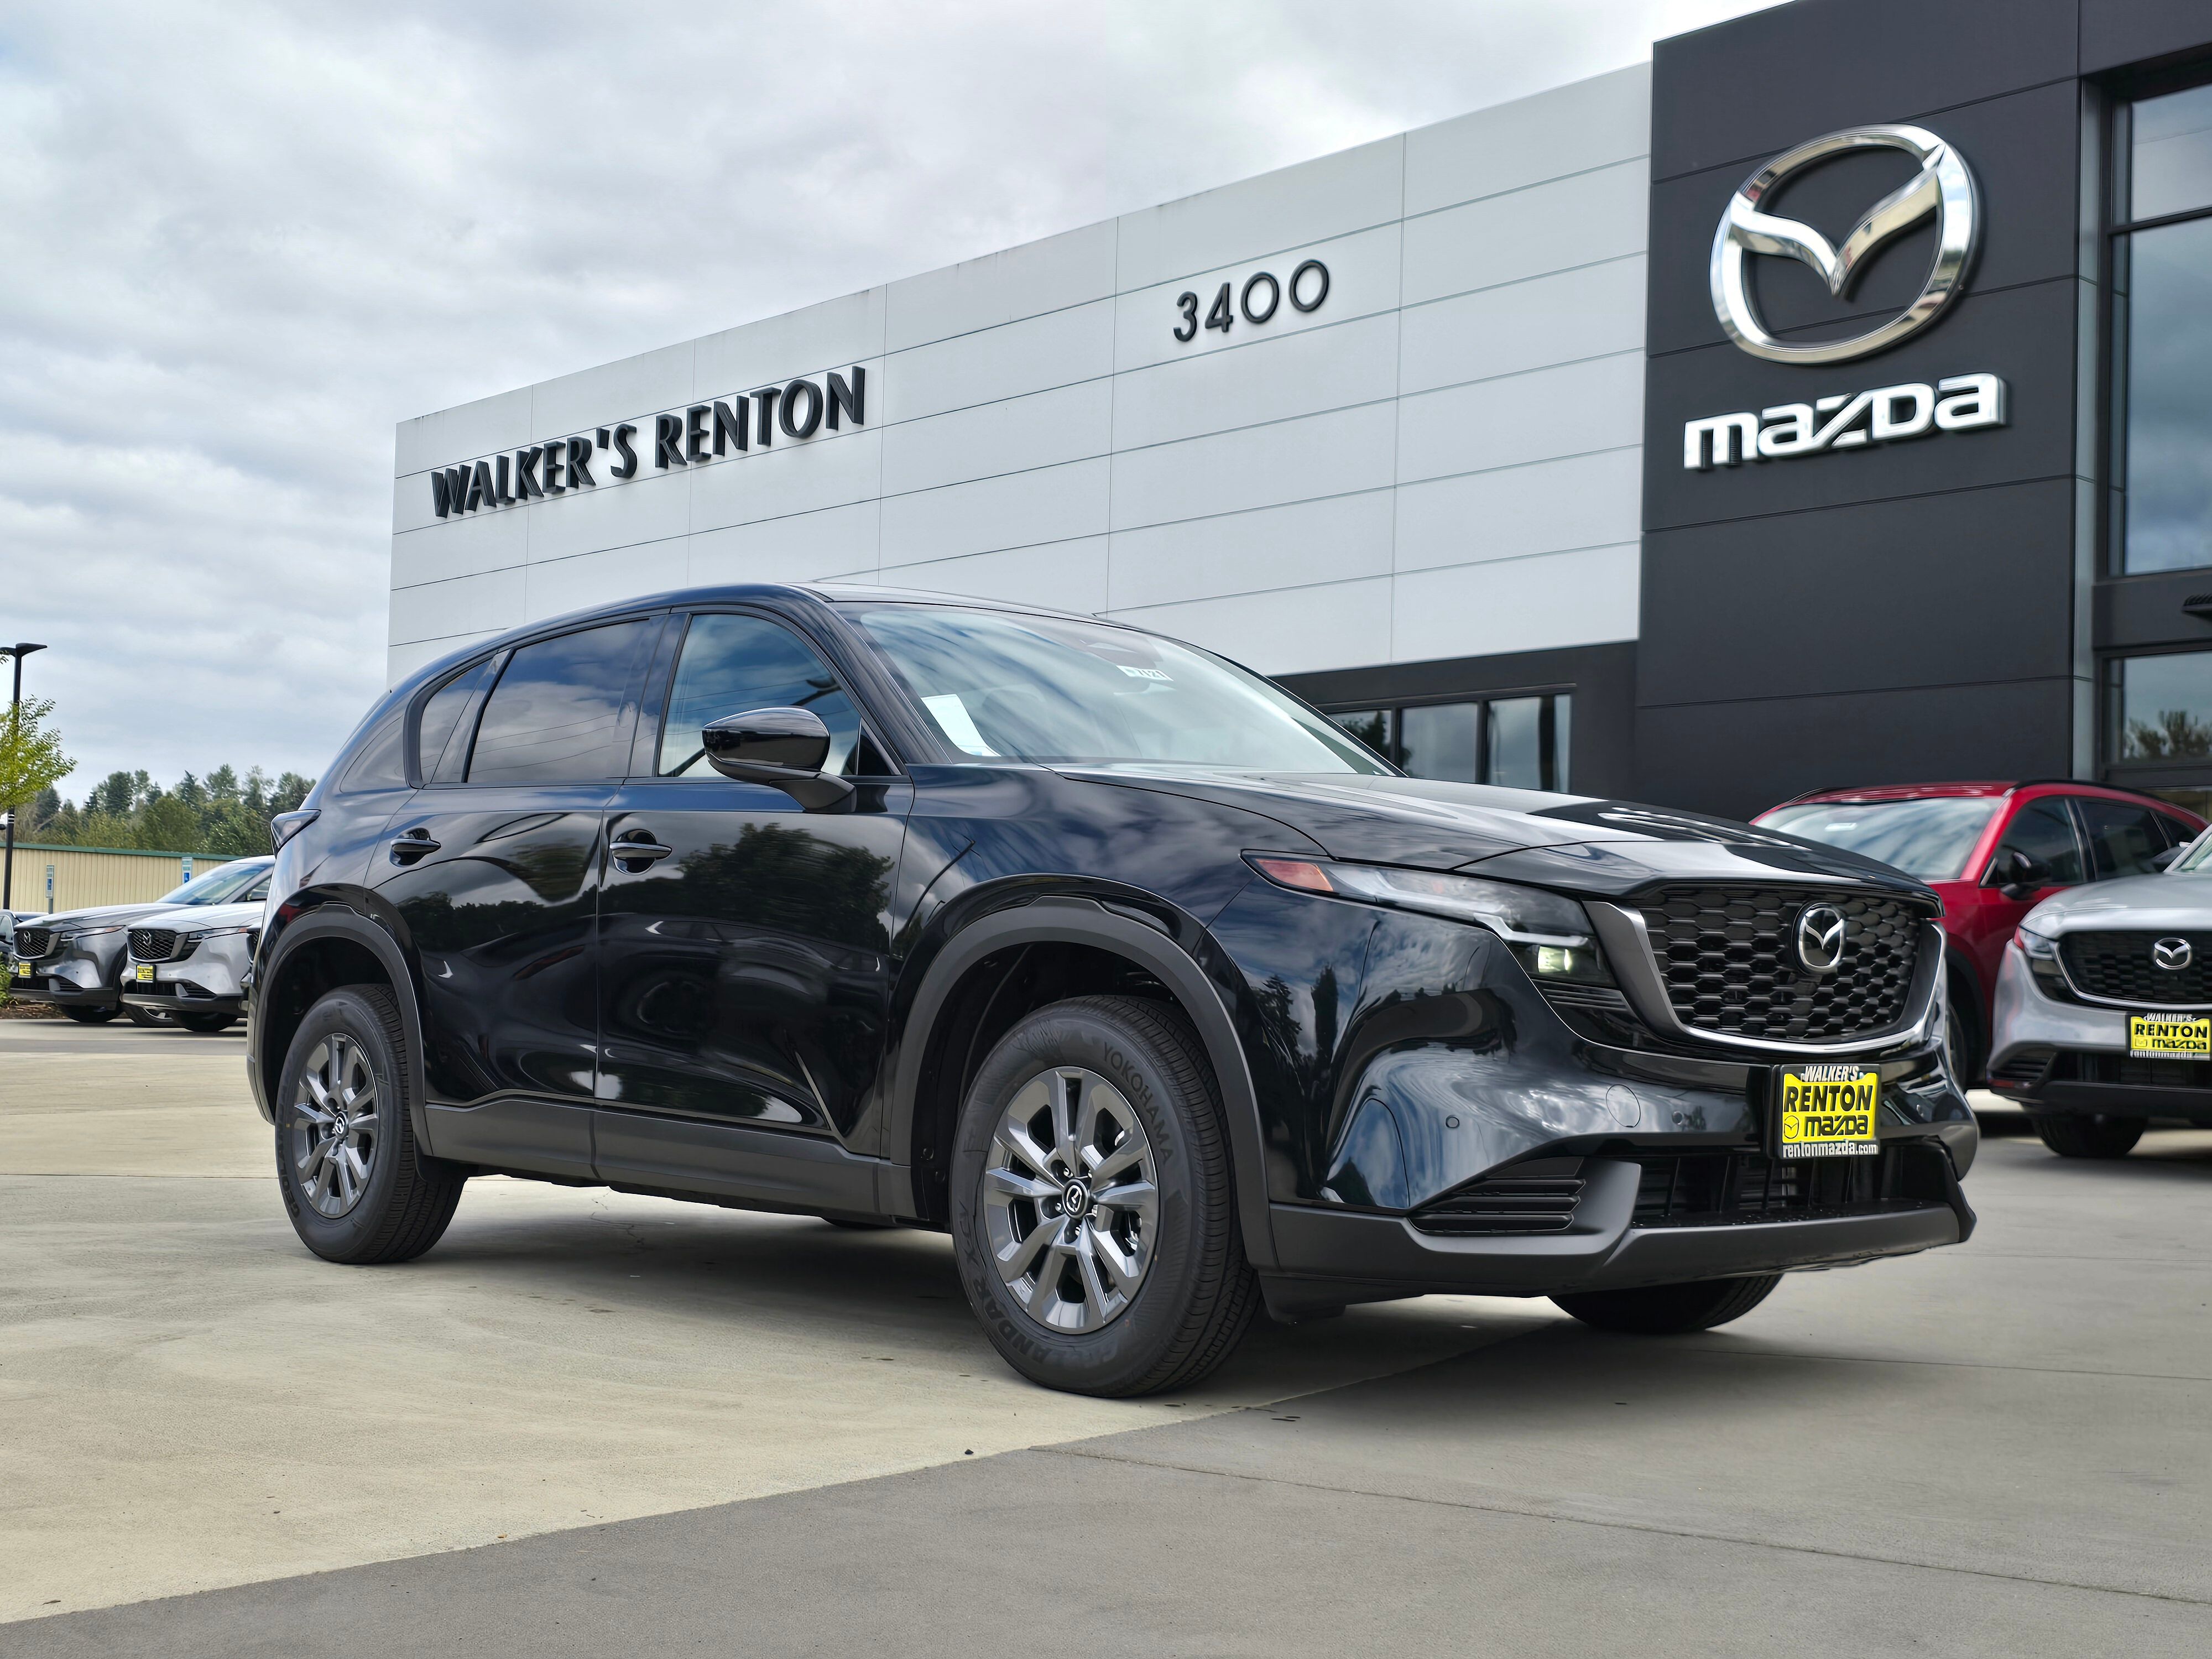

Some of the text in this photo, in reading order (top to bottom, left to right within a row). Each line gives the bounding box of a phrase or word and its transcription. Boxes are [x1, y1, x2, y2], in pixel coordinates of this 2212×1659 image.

[1173, 258, 1331, 342] 3400
[1684, 372, 2008, 470] mazda
[431, 366, 866, 518] WALKER'S RENTON
[2135, 1024, 2208, 1038] RENTON
[2152, 1039, 2207, 1050] mazda
[1804, 1066, 1859, 1082] WALKER'S
[1104, 1041, 1173, 1165] YOKOHAMA
[1783, 1085, 1873, 1113] RENTON
[1804, 1115, 1868, 1137] mazda
[1782, 1139, 1879, 1158] rentonmazda.com
